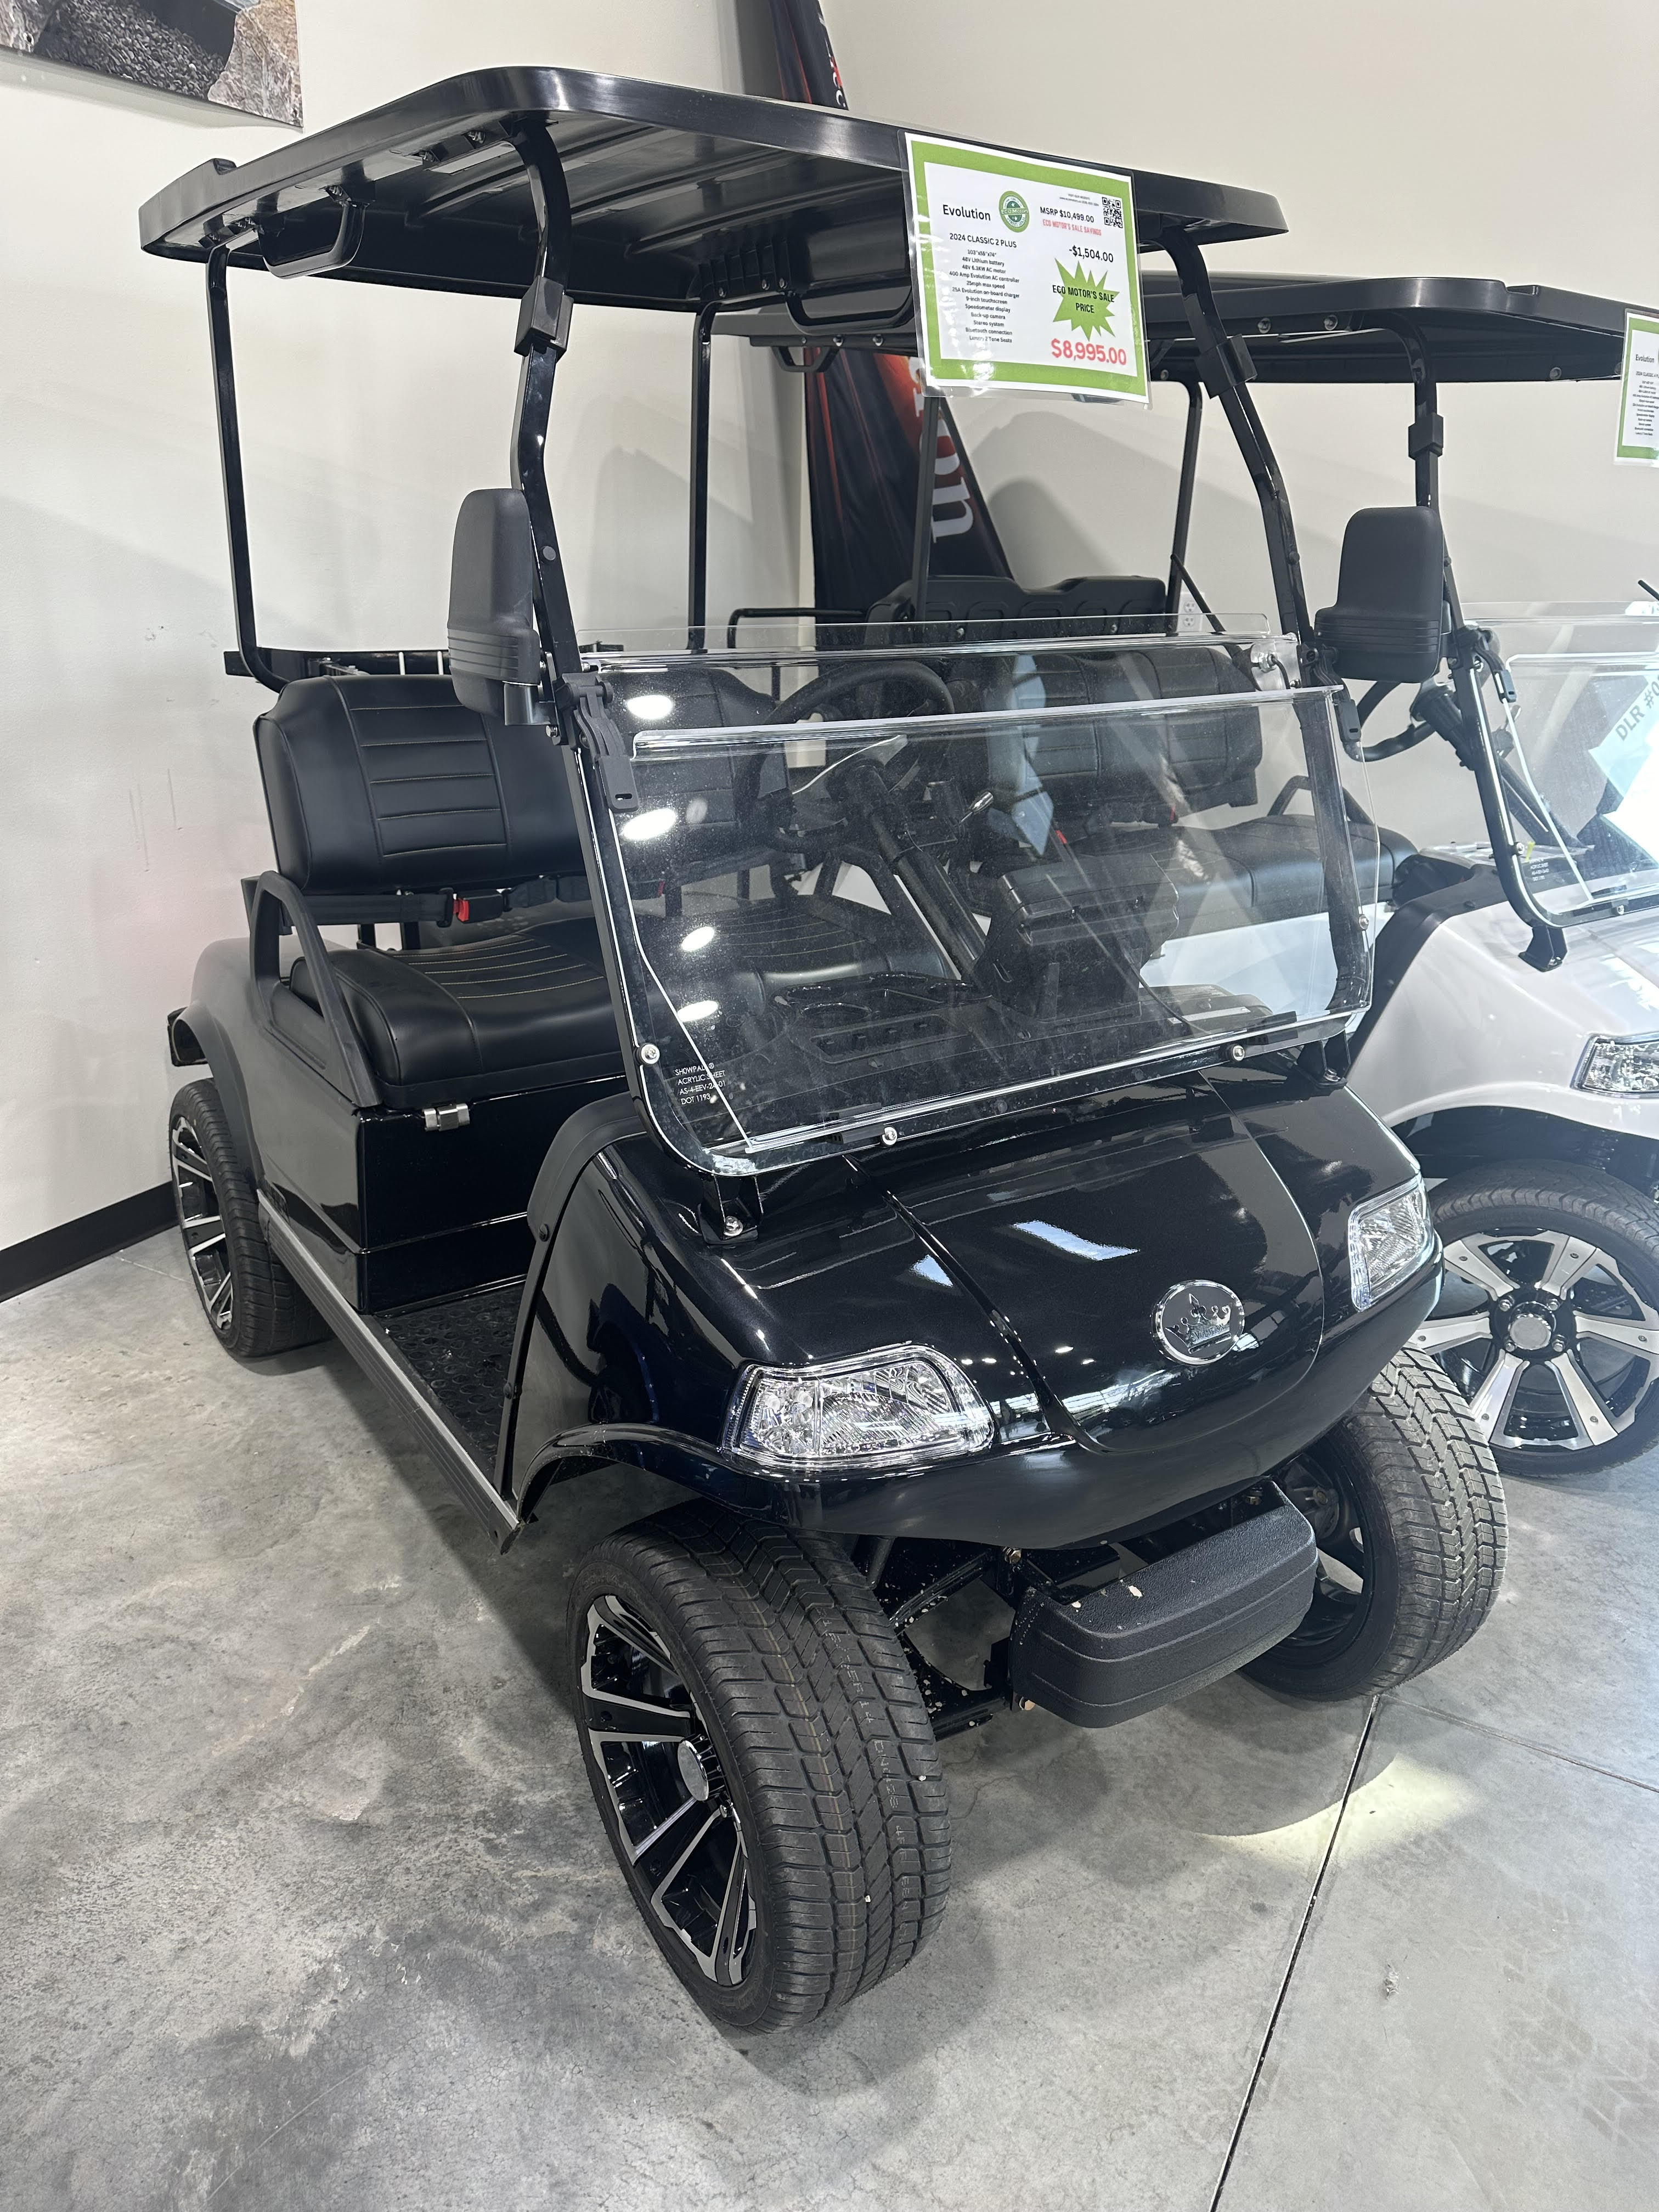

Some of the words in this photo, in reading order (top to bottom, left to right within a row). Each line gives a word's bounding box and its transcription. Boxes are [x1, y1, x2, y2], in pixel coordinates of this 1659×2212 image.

[943, 204, 991, 221] Evolution
[1040, 206, 1058, 216] MSRP
[1059, 210, 1094, 223] $10,499.00
[1052, 221, 1071, 230] MOTOR'S
[1071, 224, 1083, 233] SALE
[1084, 227, 1102, 236] SAVINGS
[949, 233, 966, 241] 2024
[967, 235, 995, 245] CLASSIC
[1001, 240, 1017, 248] PLUS
[1069, 245, 1114, 263] -$1,504.00
[1052, 285, 1066, 294] ECO
[1068, 287, 1097, 300] MOTOR'S
[1099, 293, 1115, 303] SALE
[1075, 303, 1094, 313] PRICE
[1051, 338, 1127, 365] $8,995.00
[1615, 705, 1645, 741] DLR
[678, 1074, 706, 1085] ACRYLIC
[681, 1096, 695, 1105] DOT
[696, 1093, 711, 1102] 1193
